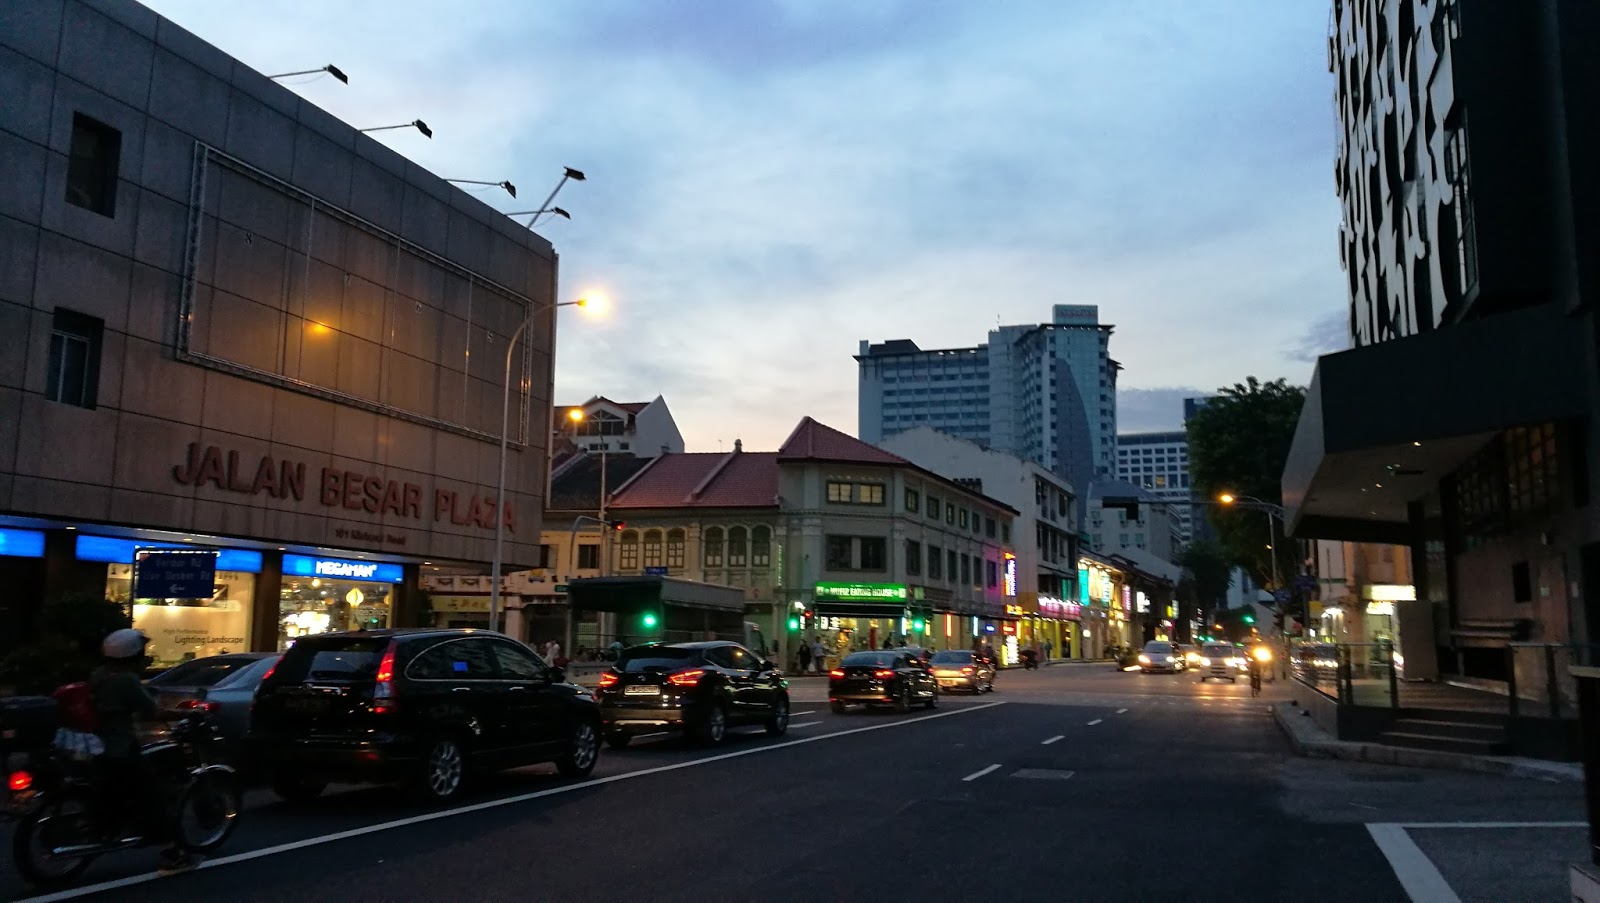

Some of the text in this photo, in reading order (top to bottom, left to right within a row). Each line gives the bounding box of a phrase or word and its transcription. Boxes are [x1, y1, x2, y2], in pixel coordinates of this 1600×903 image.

[173, 442, 517, 533] JALAN BESAR PLAZA
[175, 635, 244, 645] Lighting Landscape
